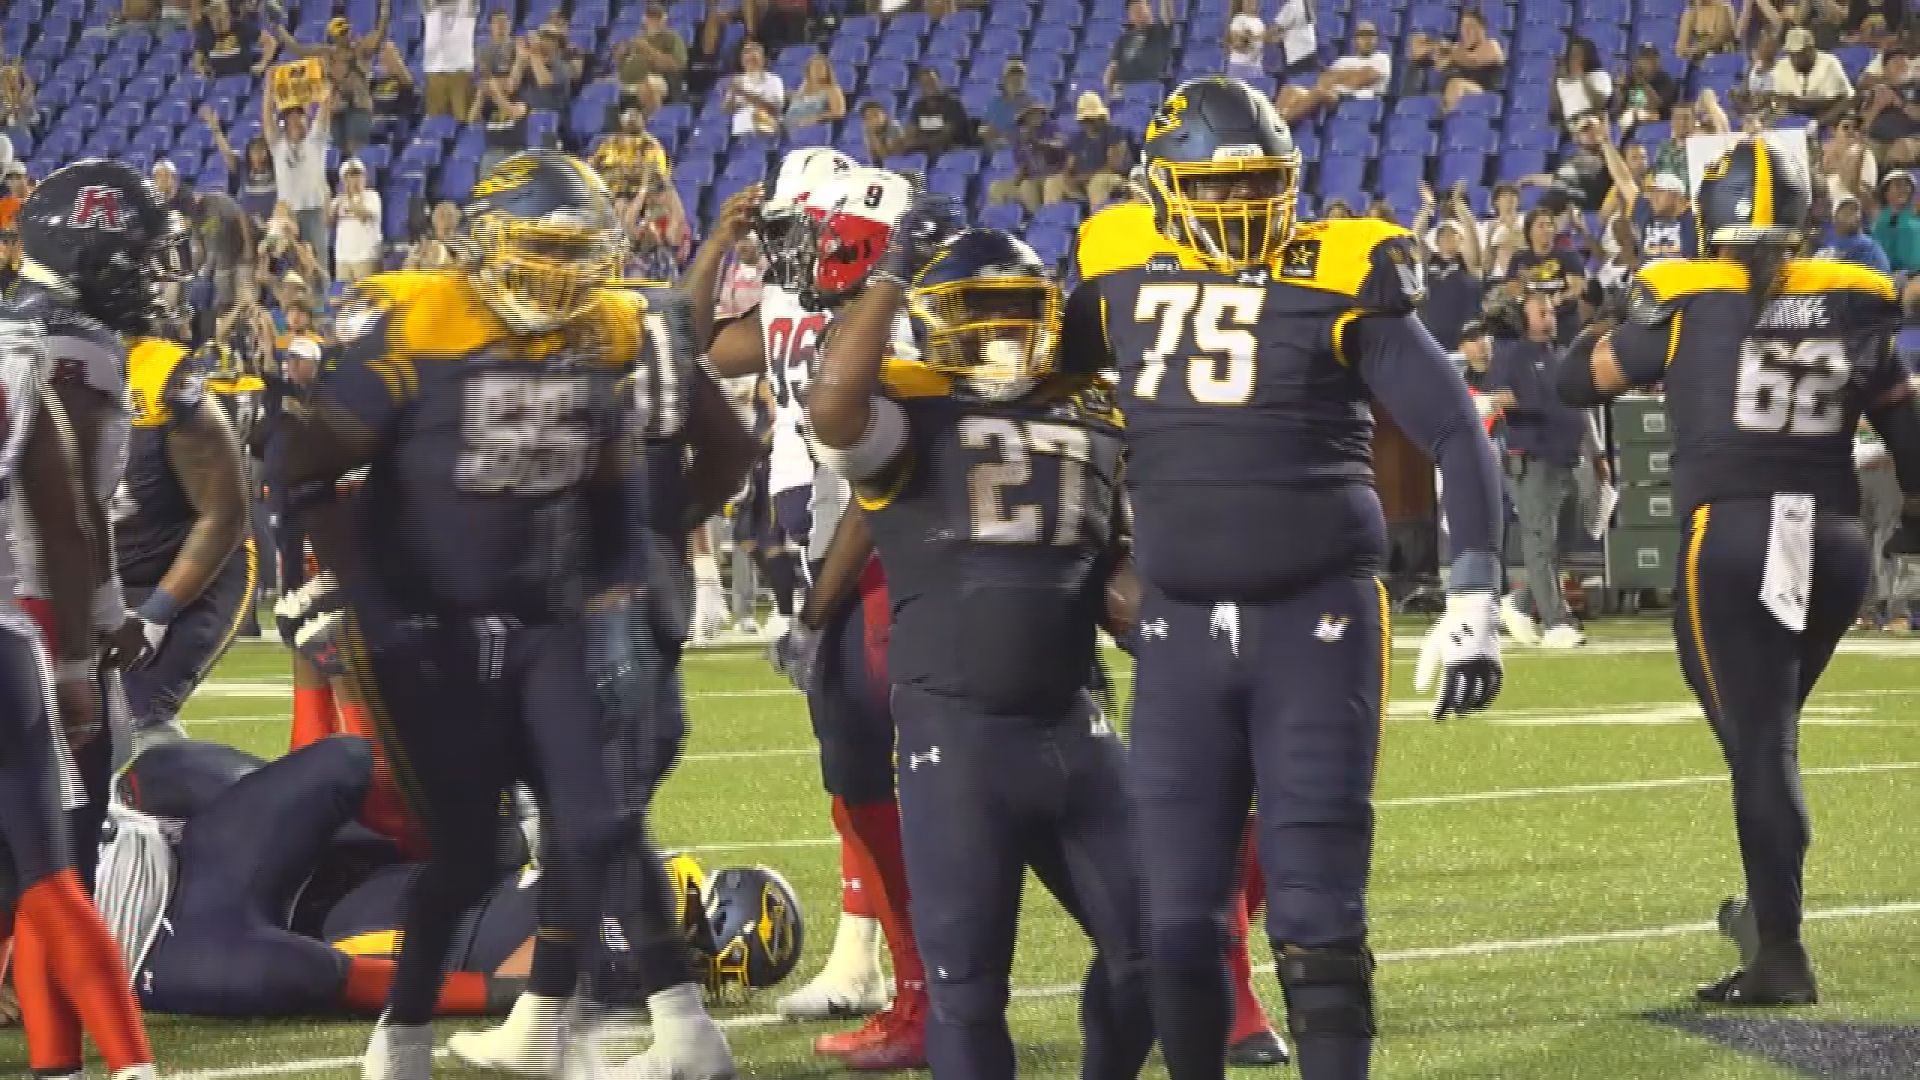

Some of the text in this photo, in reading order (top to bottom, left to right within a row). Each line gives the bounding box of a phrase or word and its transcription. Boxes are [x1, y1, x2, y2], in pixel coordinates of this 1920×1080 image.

[863, 184, 884, 208] 9
[1134, 282, 1266, 406] 75
[1734, 336, 1851, 435] 62
[455, 371, 592, 495] 55
[957, 415, 1092, 546] 27
